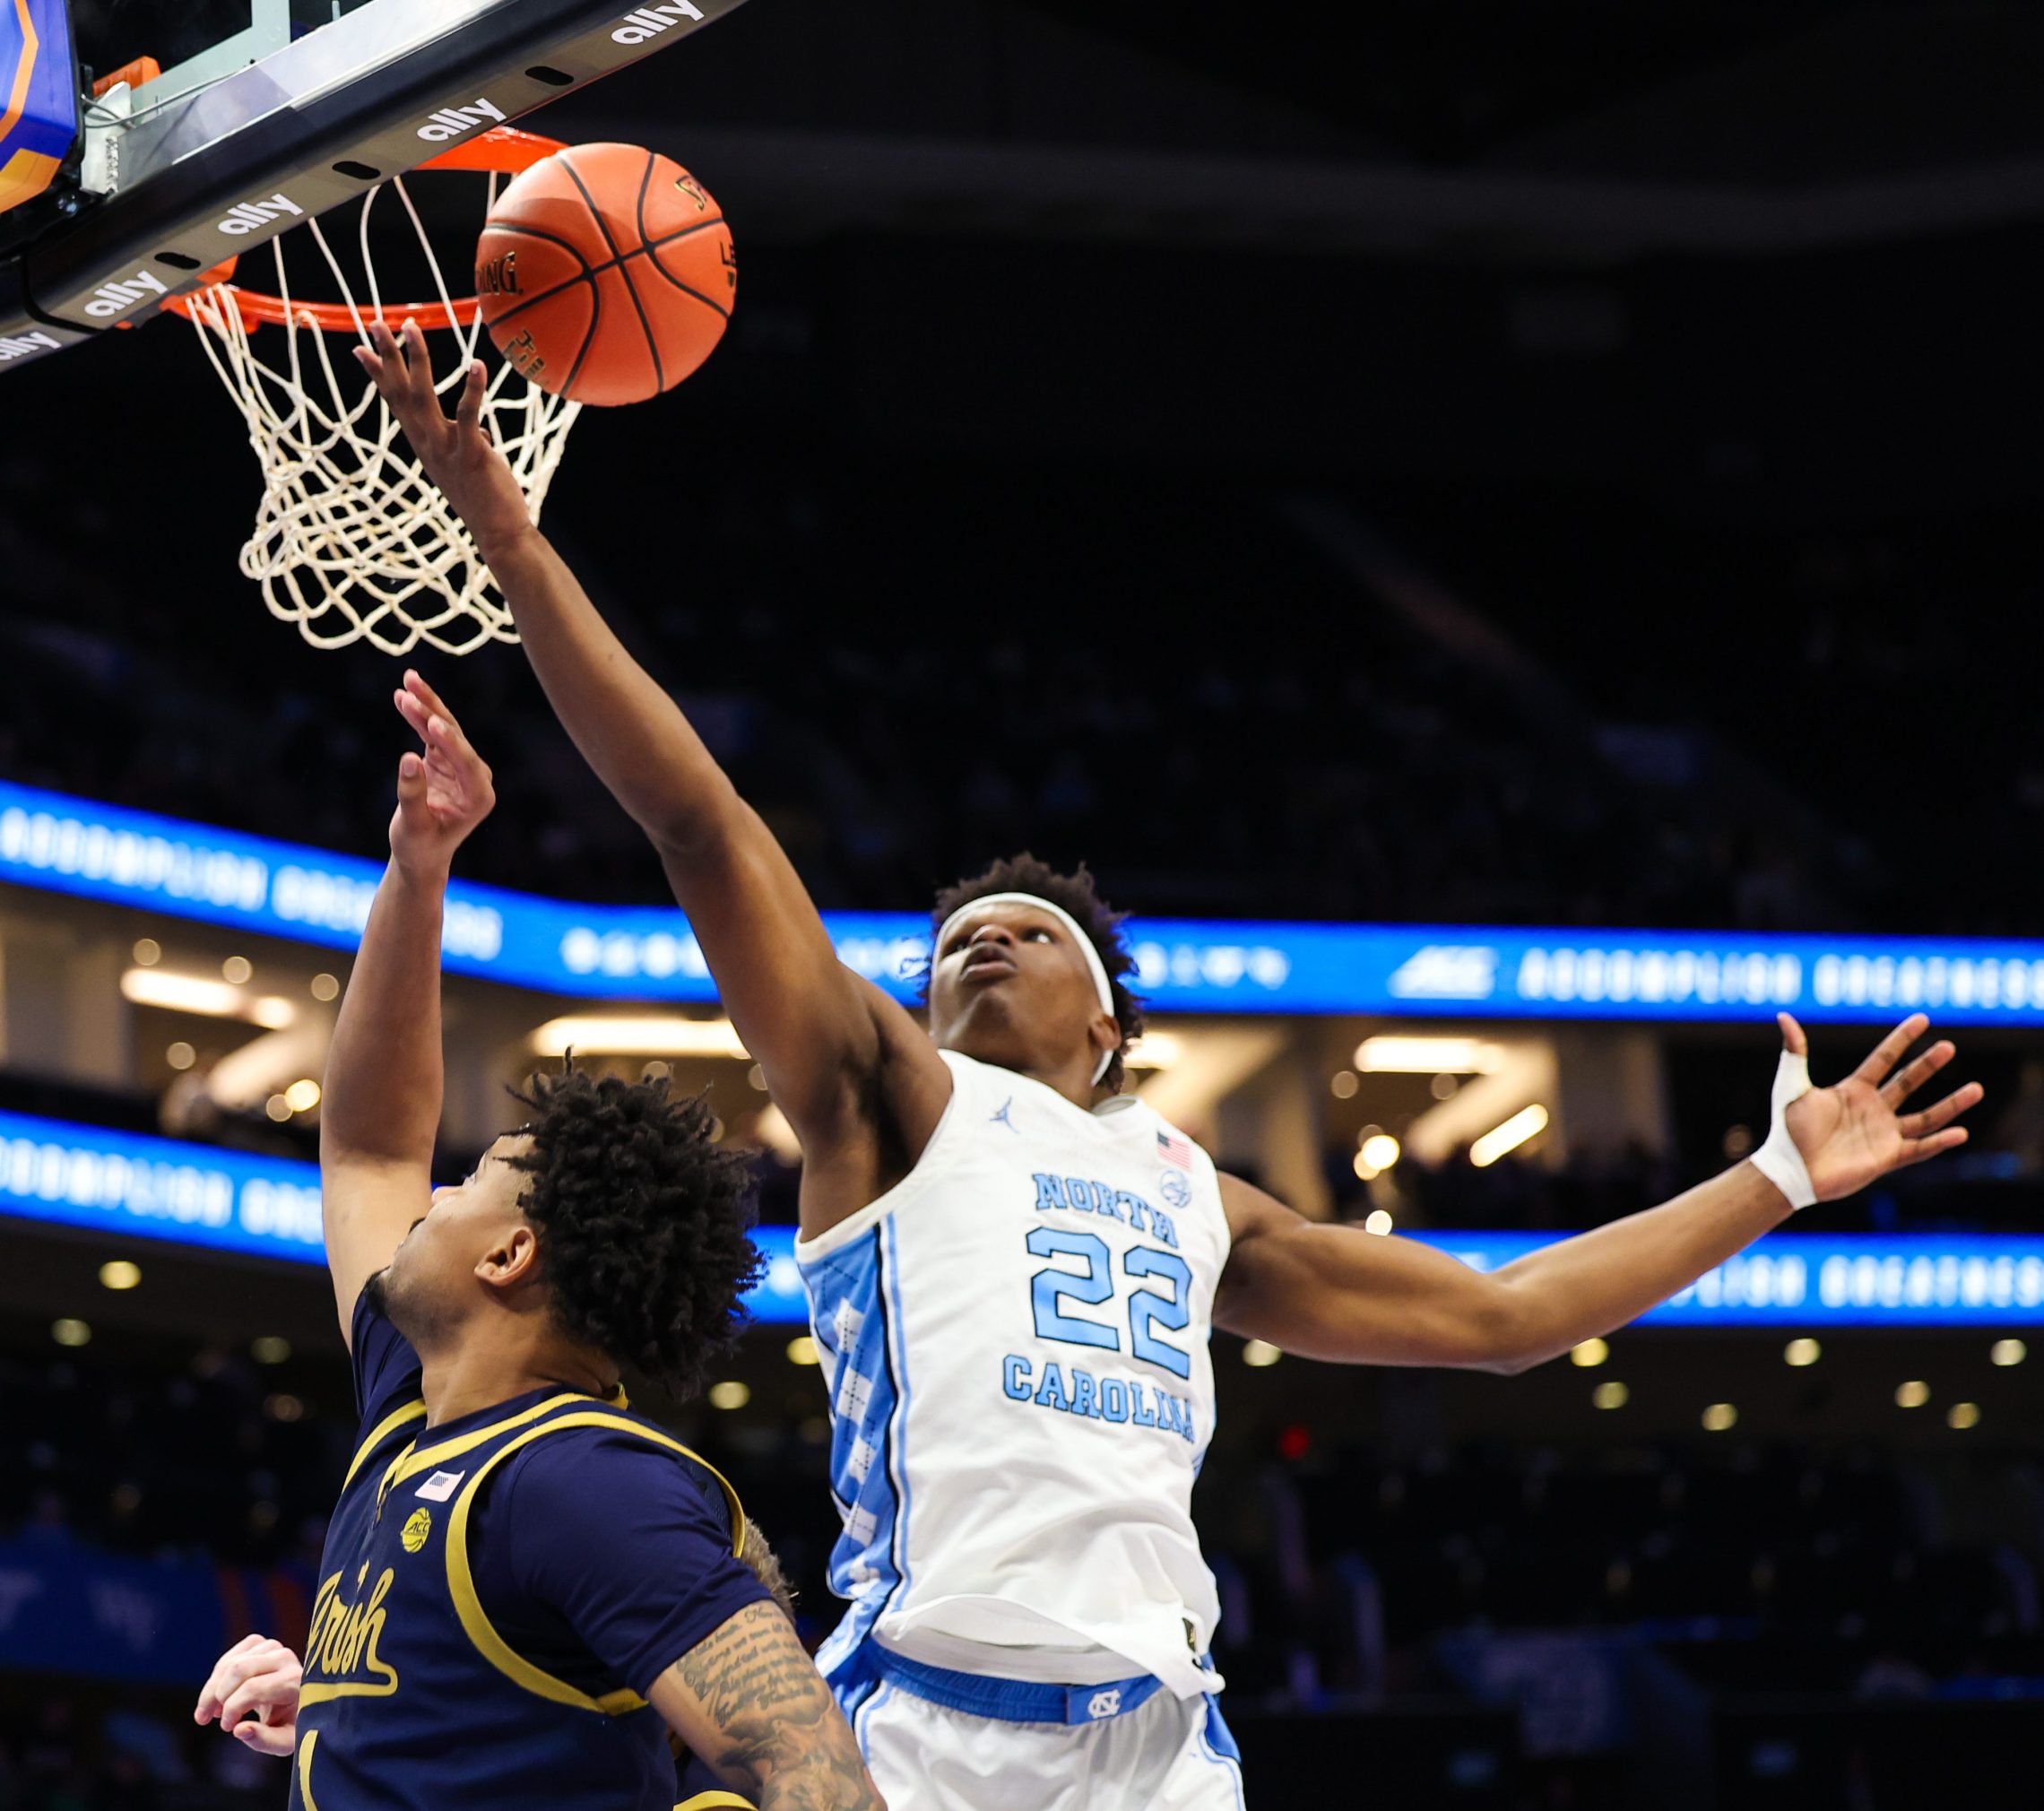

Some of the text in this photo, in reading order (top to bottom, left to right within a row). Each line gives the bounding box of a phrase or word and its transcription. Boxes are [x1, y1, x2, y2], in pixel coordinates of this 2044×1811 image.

[611, 0, 705, 45] ally
[418, 98, 507, 142] ally
[218, 193, 304, 235] ally
[84, 270, 169, 316] ally
[1032, 1172, 1179, 1249] NORTH
[1026, 1226, 1193, 1381] 22
[1002, 1353, 1196, 1444] CAROLINA
